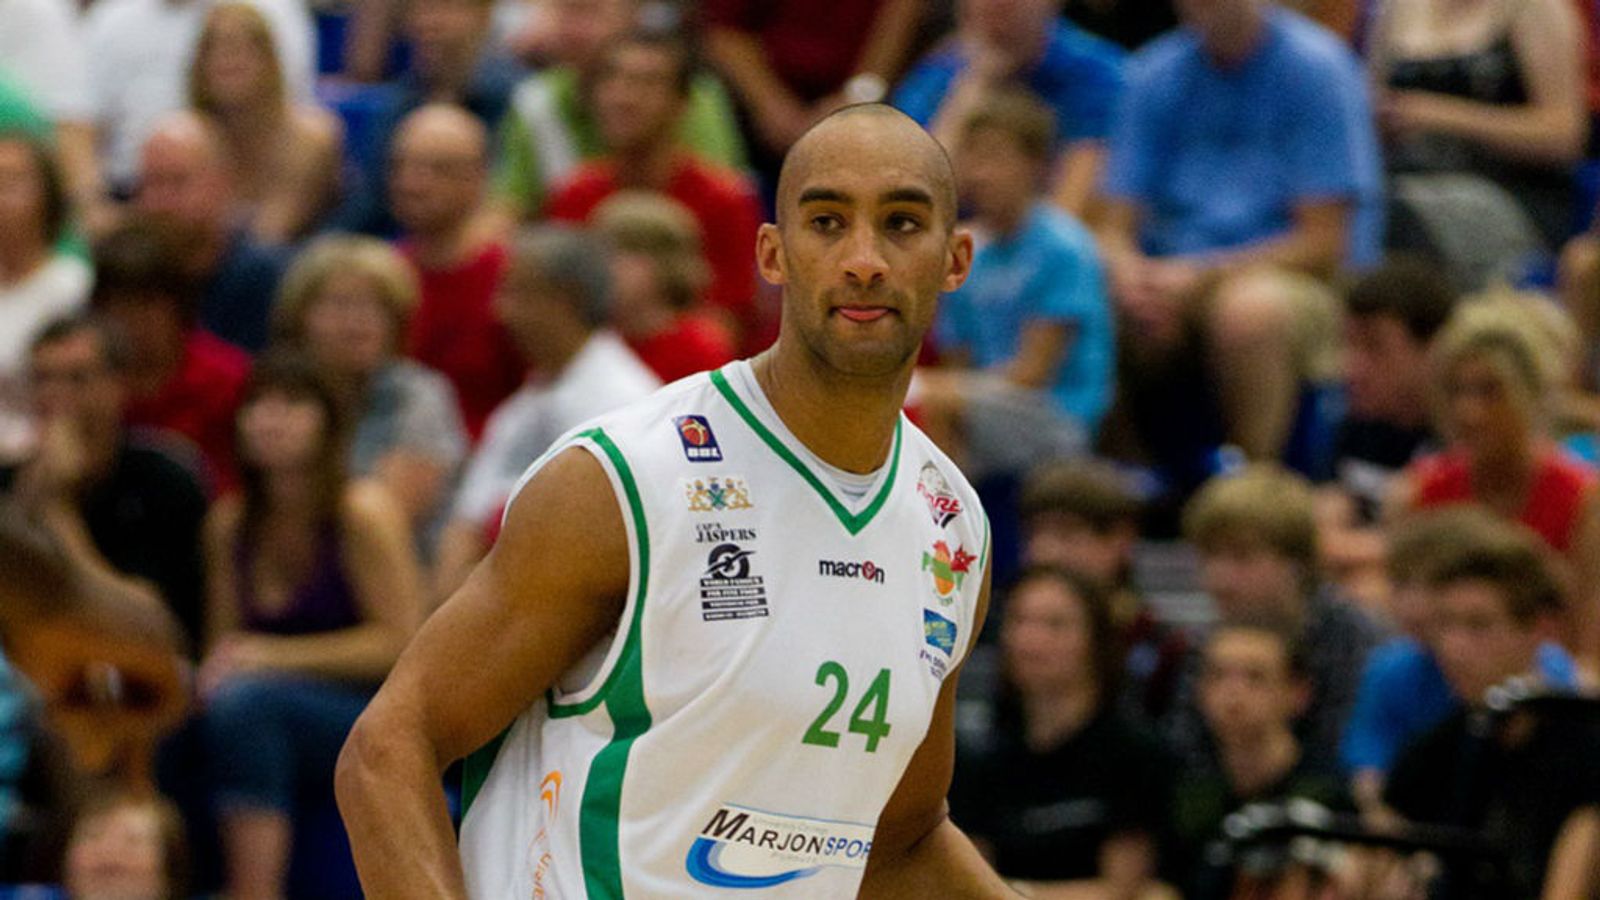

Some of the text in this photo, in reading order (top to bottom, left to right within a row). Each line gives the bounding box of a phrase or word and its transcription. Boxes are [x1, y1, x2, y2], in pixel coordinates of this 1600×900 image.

[696, 528, 757, 543] JASPERS
[819, 560, 885, 584] macron
[801, 660, 892, 753] 24
